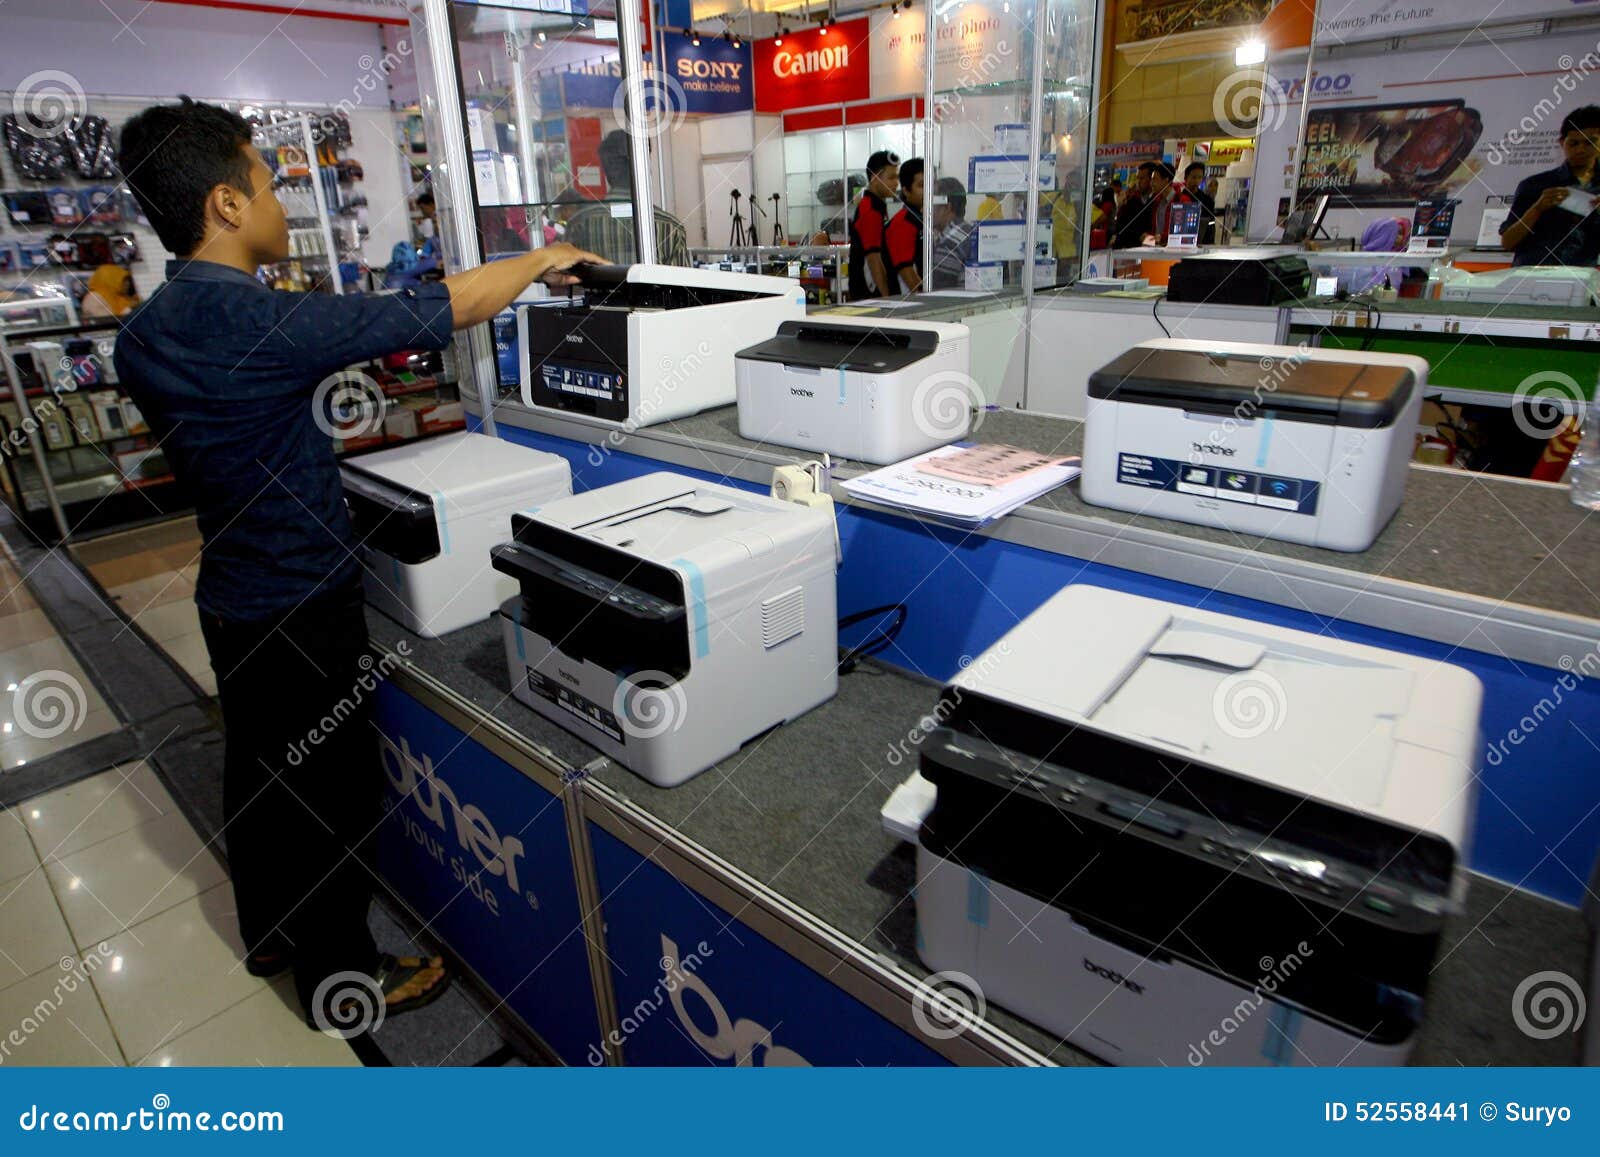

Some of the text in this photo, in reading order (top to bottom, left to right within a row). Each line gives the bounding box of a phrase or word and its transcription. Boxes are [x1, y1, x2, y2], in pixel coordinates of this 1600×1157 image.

[961, 17, 1000, 39] photo
[1319, 7, 1434, 32] Towards The Future
[677, 57, 743, 80] SONY
[773, 44, 849, 78] Canon
[791, 387, 815, 398] brother
[1191, 442, 1237, 458] brother
[400, 814, 447, 867] your
[450, 856, 501, 918] side
[1082, 957, 1146, 995] brother
